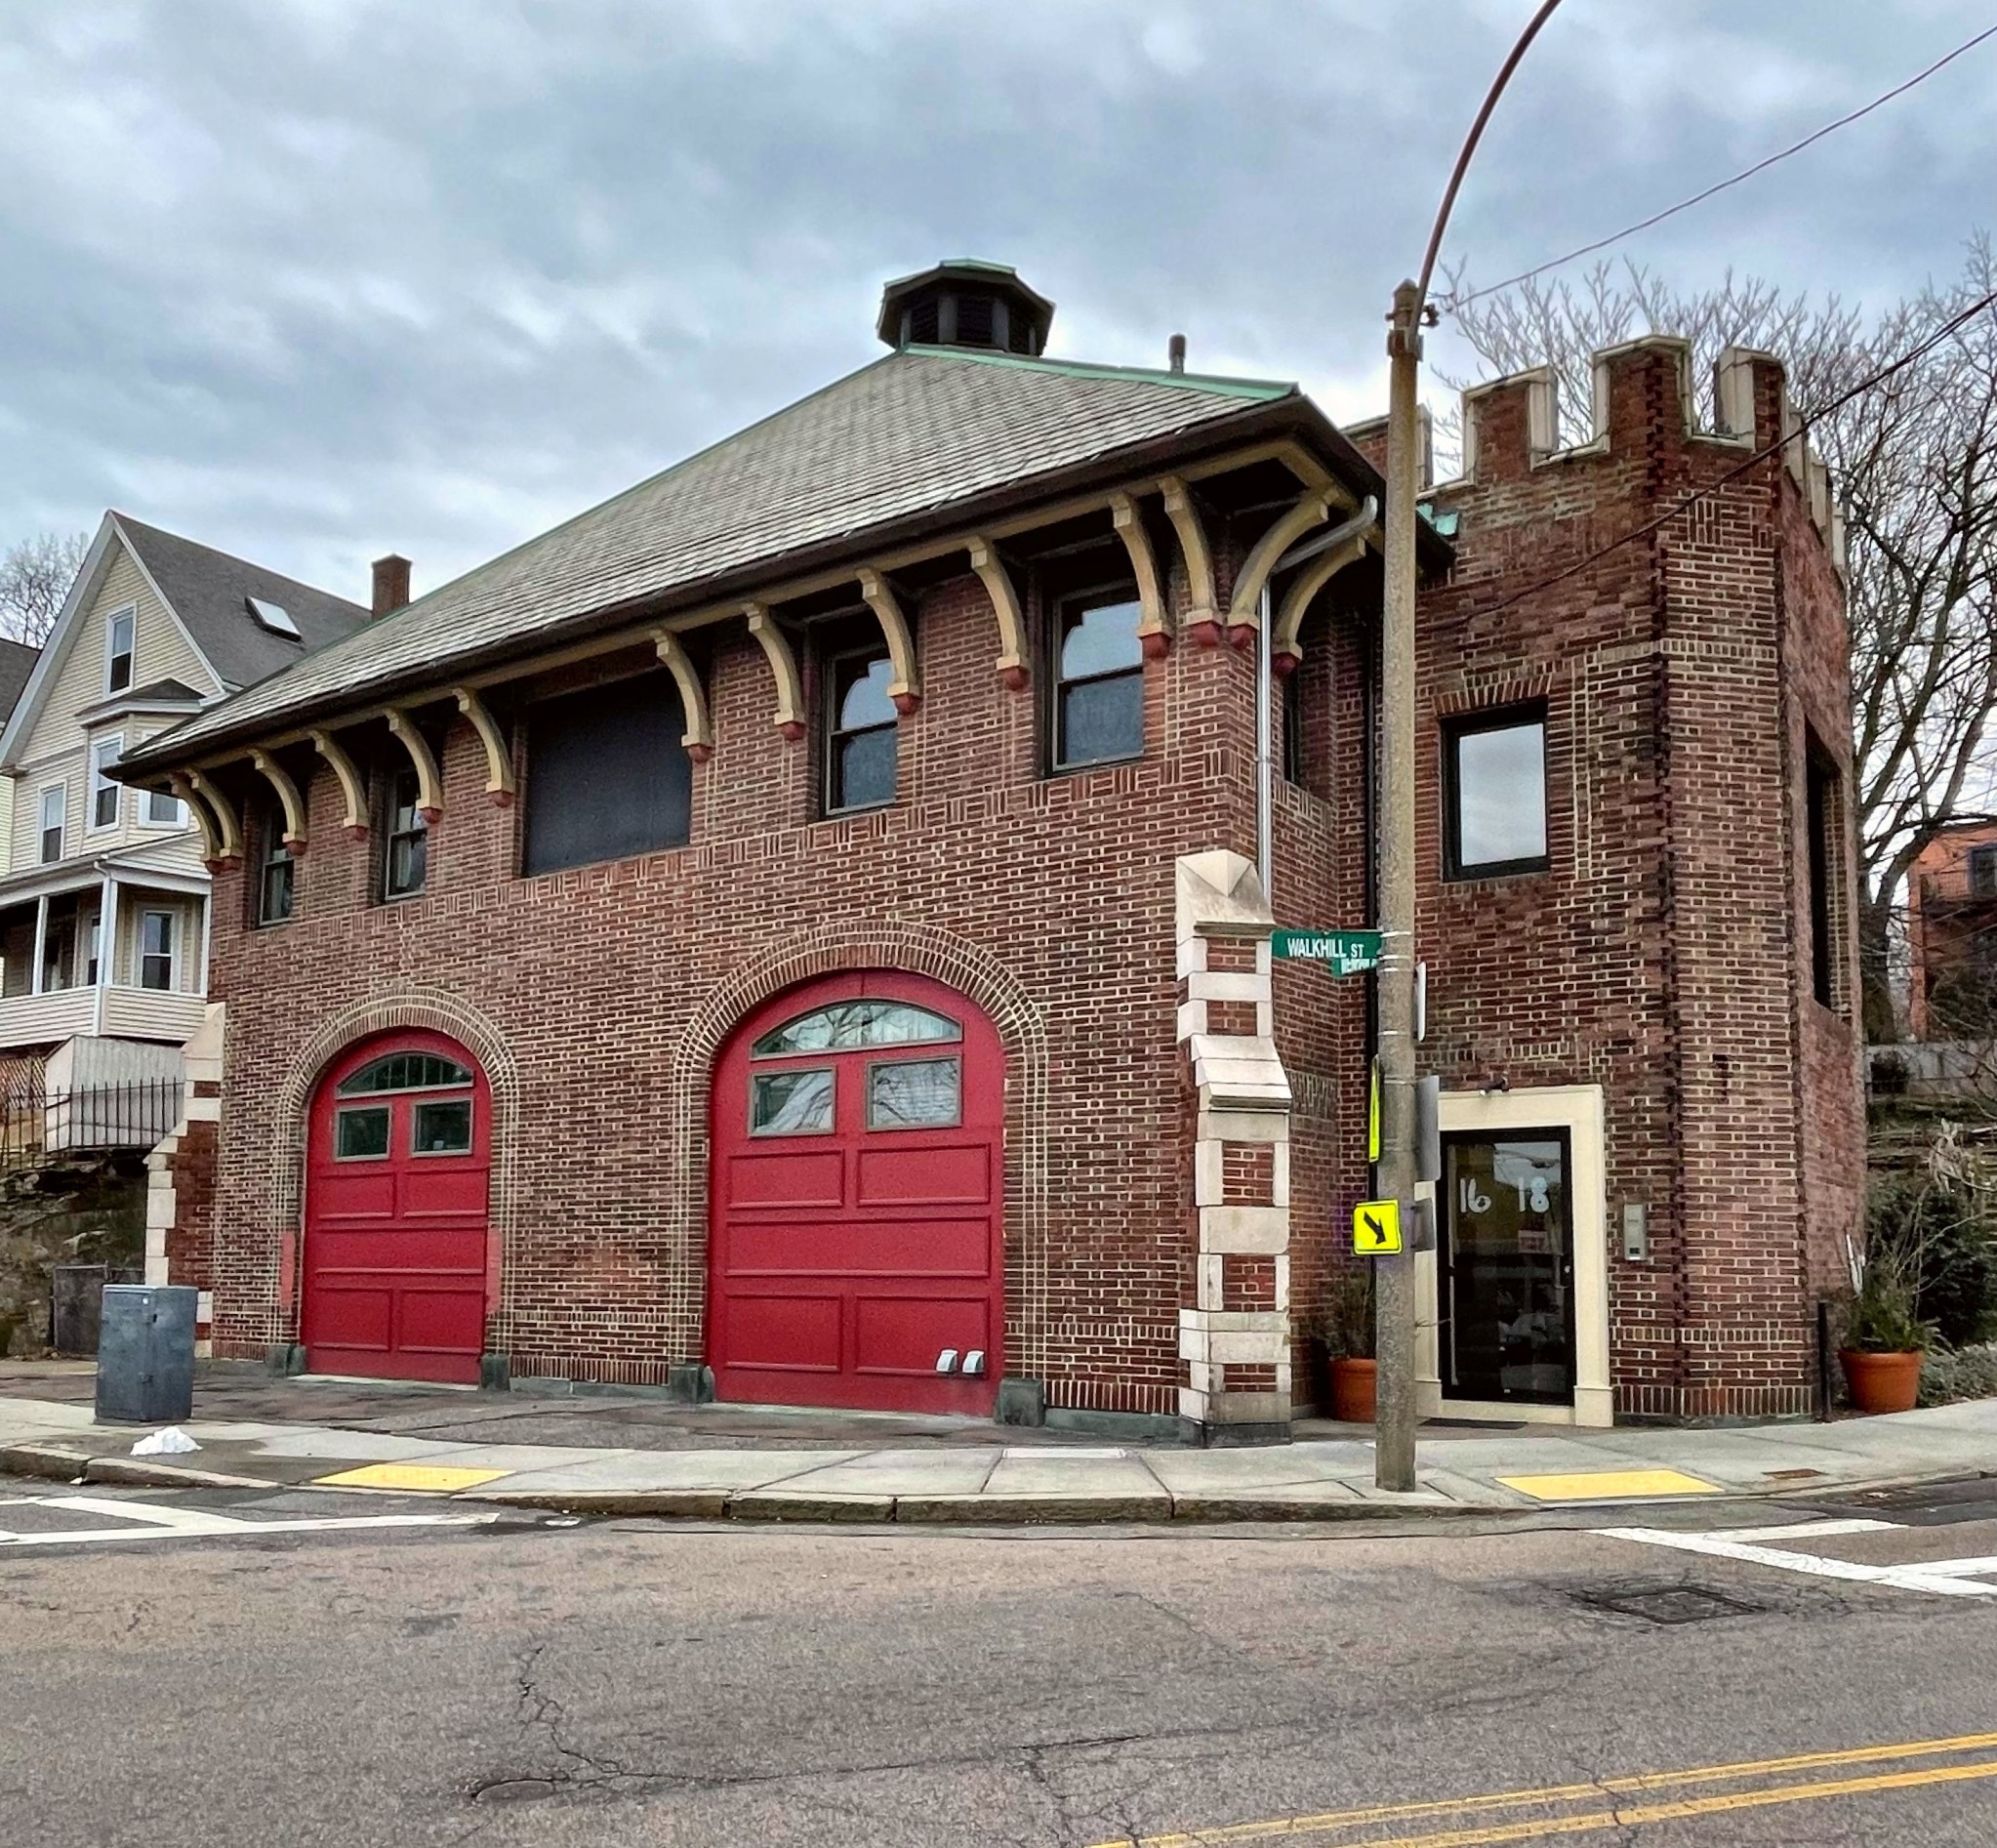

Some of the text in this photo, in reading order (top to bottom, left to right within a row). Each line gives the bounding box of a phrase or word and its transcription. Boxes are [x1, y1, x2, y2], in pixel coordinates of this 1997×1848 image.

[1350, 943, 1365, 958] ST
[1460, 1176, 1550, 1213] 16 18
